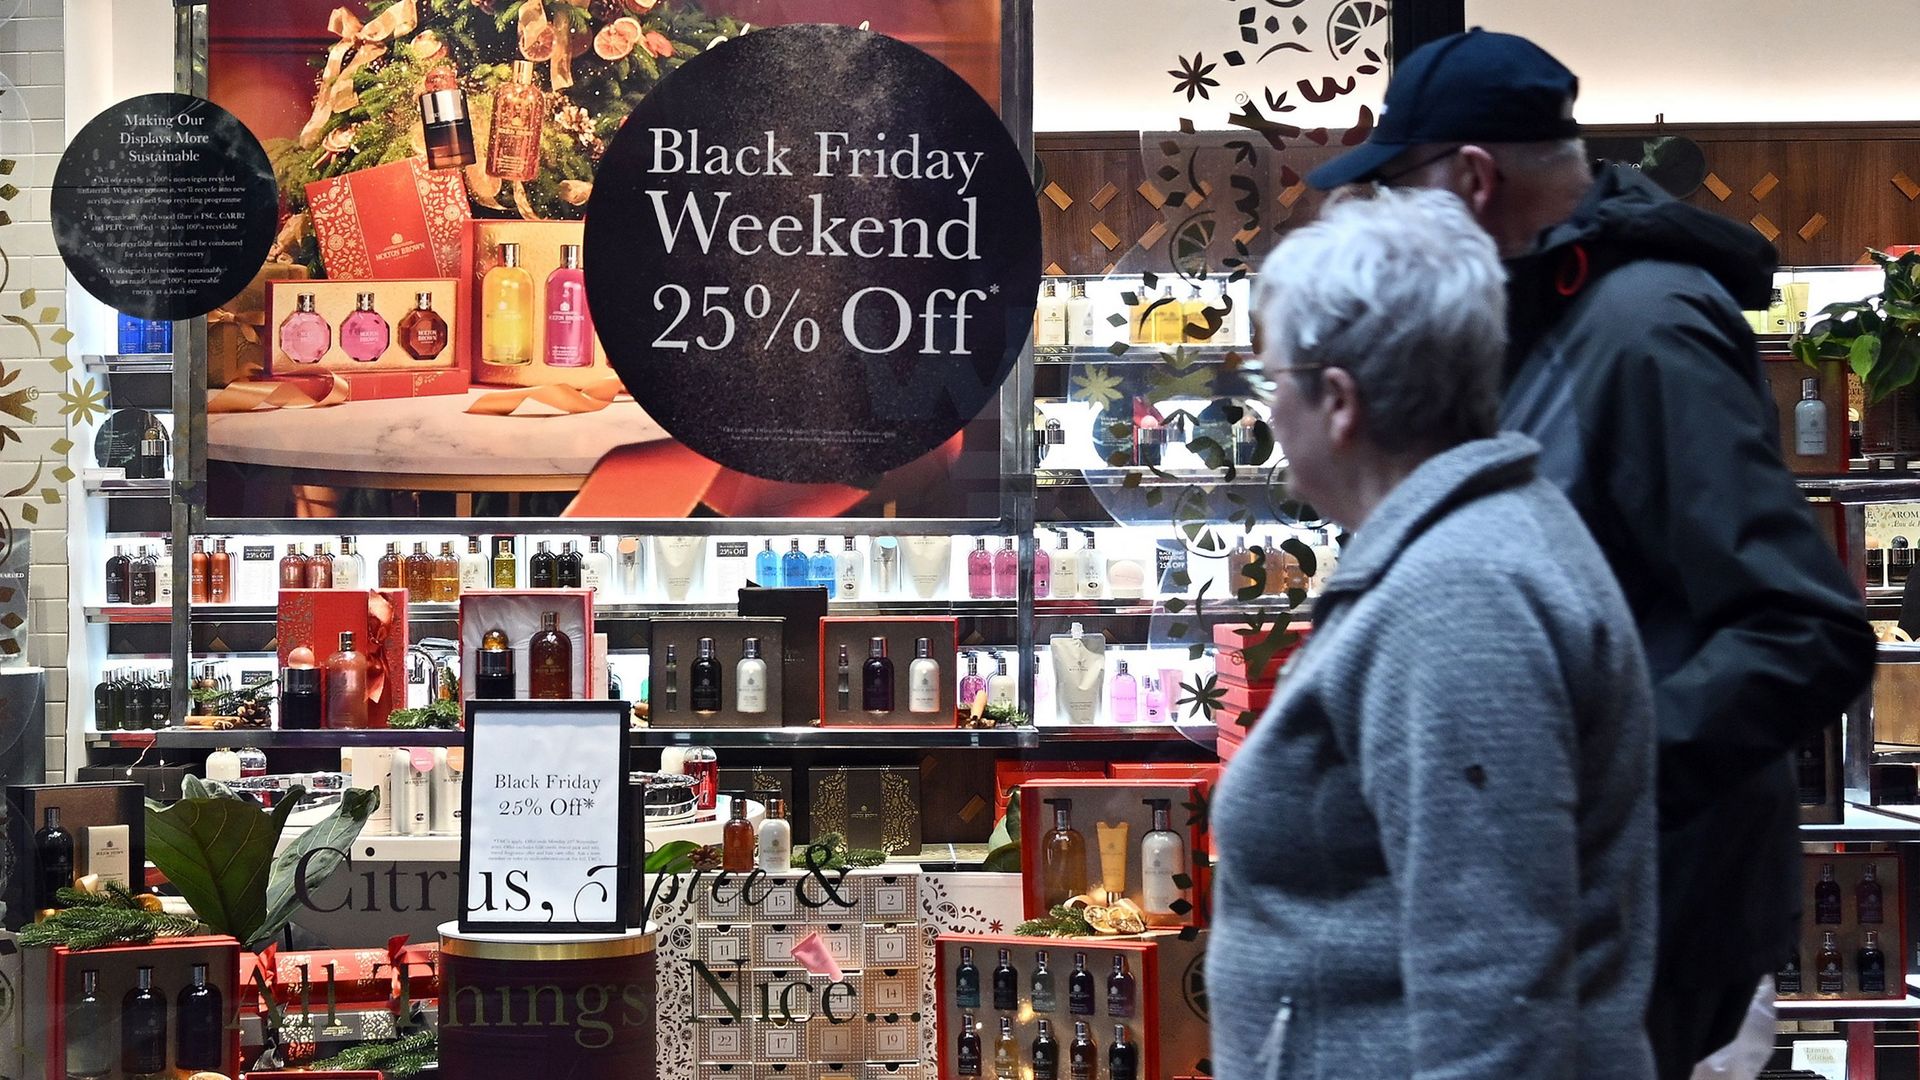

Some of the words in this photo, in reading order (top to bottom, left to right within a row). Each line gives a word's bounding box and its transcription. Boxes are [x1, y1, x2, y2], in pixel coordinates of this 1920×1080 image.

[124, 114, 174, 128] Making
[178, 113, 205, 126] Our
[120, 132, 172, 148] Displays
[175, 131, 209, 144] More
[128, 150, 200, 162] Sustainable
[646, 127, 793, 176] Black
[812, 131, 985, 195] Friday
[208, 175, 236, 184] recycled
[194, 186, 217, 194] recycle
[644, 189, 982, 261] Weekend
[650, 283, 821, 354] 25%
[495, 774, 539, 789] Black
[546, 774, 601, 794] Friday
[499, 798, 542, 816] 25%
[294, 846, 554, 924] Citrus,
[796, 844, 858, 908] &
[774, 895, 786, 906] 15
[886, 895, 894, 906] 2
[776, 942, 784, 953] 7
[830, 942, 842, 952] 13
[886, 942, 894, 952] 9
[886, 988, 896, 998] 14
[225, 963, 338, 1029] All
[373, 963, 650, 1049] Things
[717, 1036, 732, 1046] 22
[775, 1038, 788, 1048] 17
[886, 1034, 898, 1046] 19
